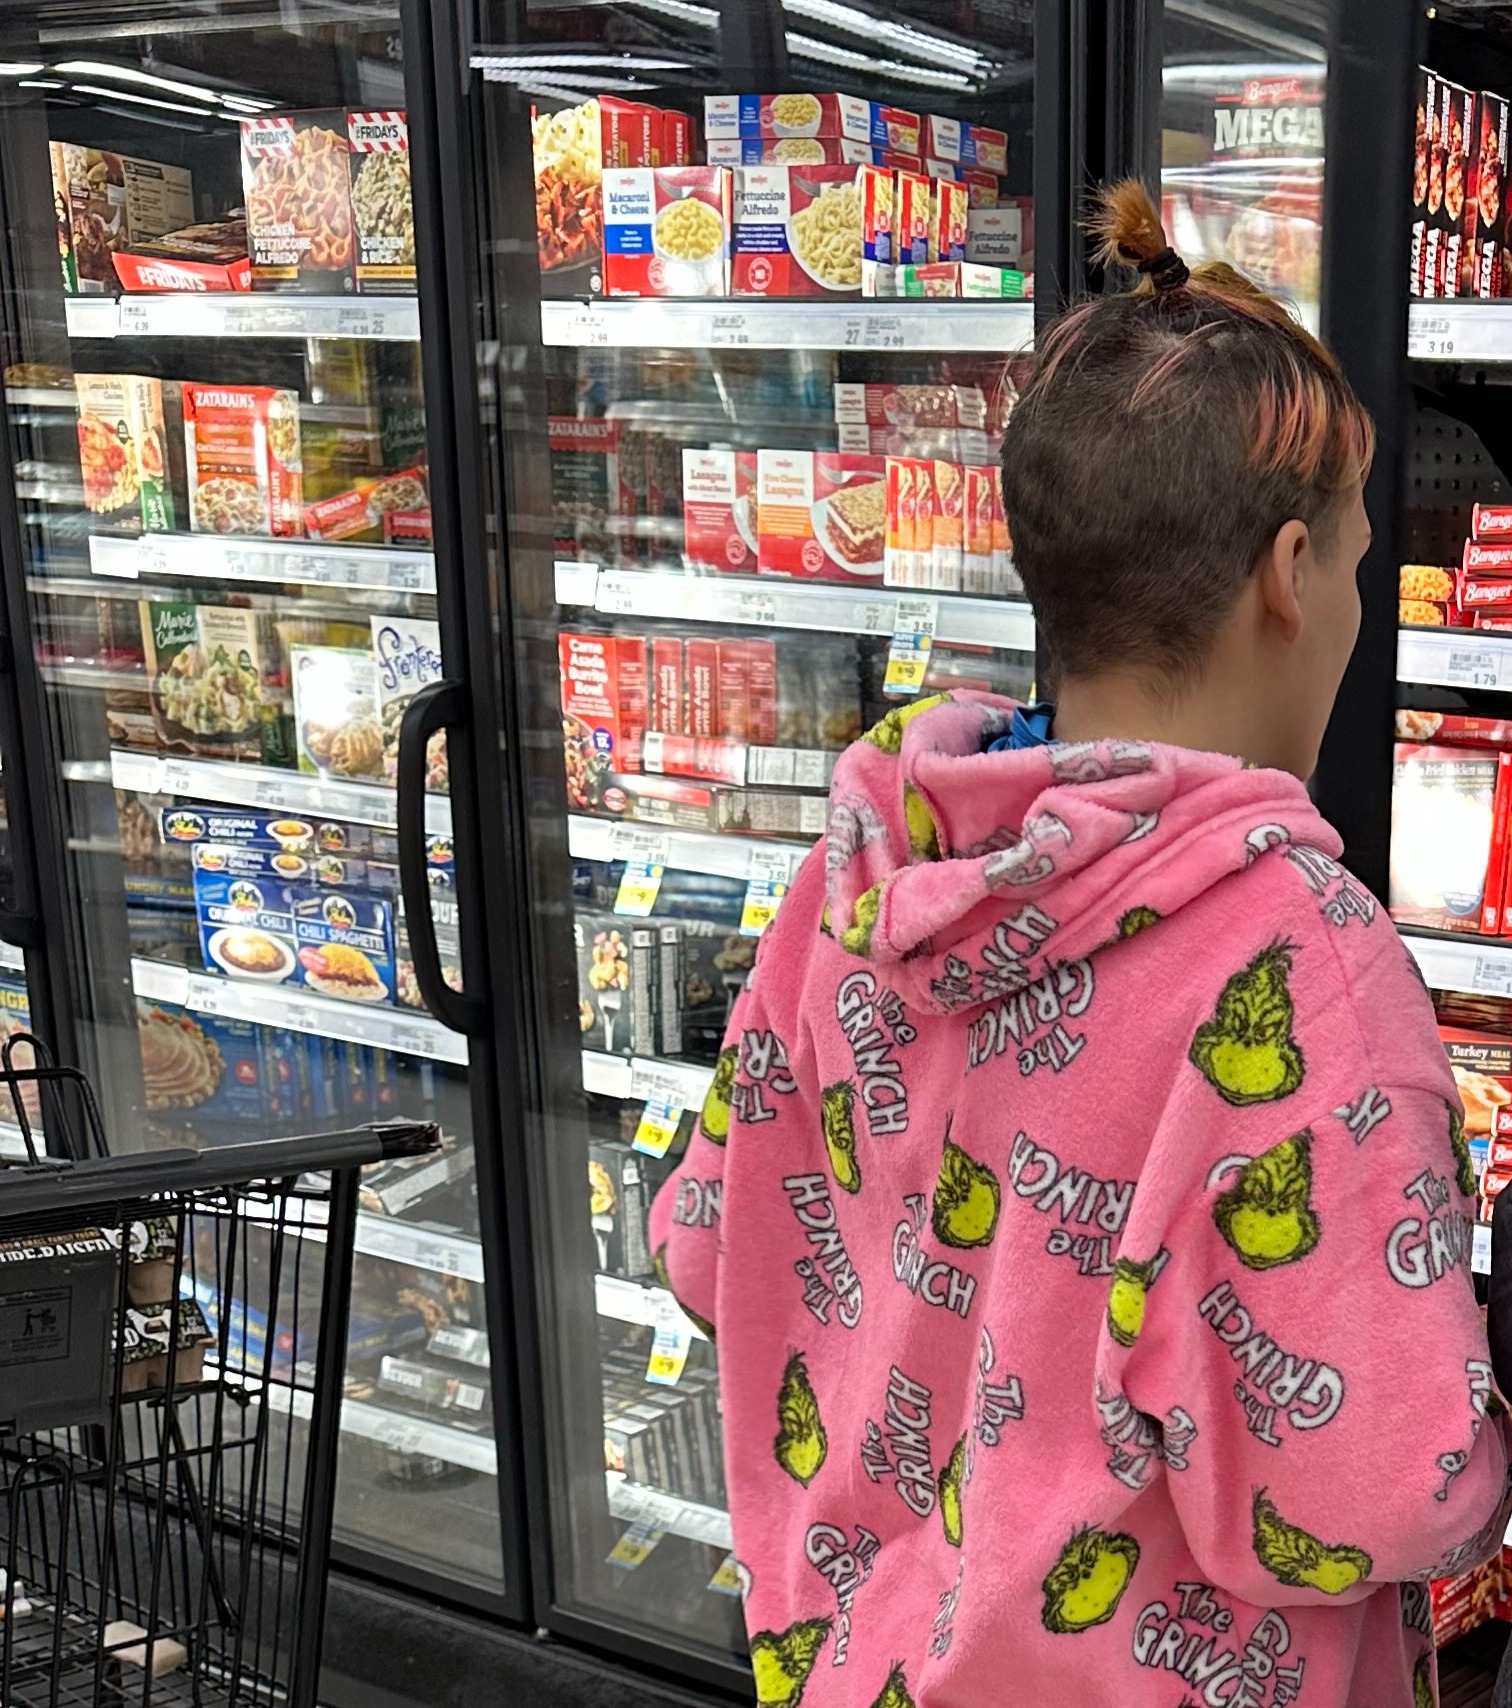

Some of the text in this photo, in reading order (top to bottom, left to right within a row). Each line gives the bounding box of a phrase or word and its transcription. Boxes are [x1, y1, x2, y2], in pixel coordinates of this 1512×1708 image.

[1249, 80, 1297, 100] Banquet
[255, 129, 290, 145] FRIDAYS
[360, 126, 399, 140] FRIDAYS
[1214, 107, 1326, 152] MEGA
[609, 192, 650, 203] Macaroni
[735, 190, 786, 202] Fettuccine
[611, 204, 650, 215] & Cheese
[741, 203, 779, 216] Alfredo
[254, 224, 295, 236] CHICKEN
[968, 230, 1018, 243] Fettuccine
[360, 237, 405, 250] CHICKEN
[974, 244, 1011, 256] Alfredo
[254, 251, 299, 264] ALFREDO
[845, 330, 860, 345] 27
[569, 655, 606, 670] Asada
[568, 668, 608, 684] Burrito
[574, 682, 604, 697] Bowl
[768, 870, 787, 881] 3.55
[259, 915, 288, 931] CHILI
[298, 921, 326, 940] CHILI
[876, 986, 918, 1044] The
[837, 970, 910, 1137] GRINCH
[1016, 1023, 1087, 1078] The
[1451, 1044, 1511, 1060] Turkey MEAL
[783, 1174, 863, 1329] GRINCH
[1046, 1230, 1117, 1277] The
[794, 1257, 834, 1326] The
[1198, 1280, 1345, 1431] GRINCH
[979, 1375, 1025, 1447] The
[1232, 1378, 1284, 1448] The
[884, 1364, 937, 1518] GRINCH
[861, 1419, 895, 1484] The
[1174, 1581, 1234, 1633] The
